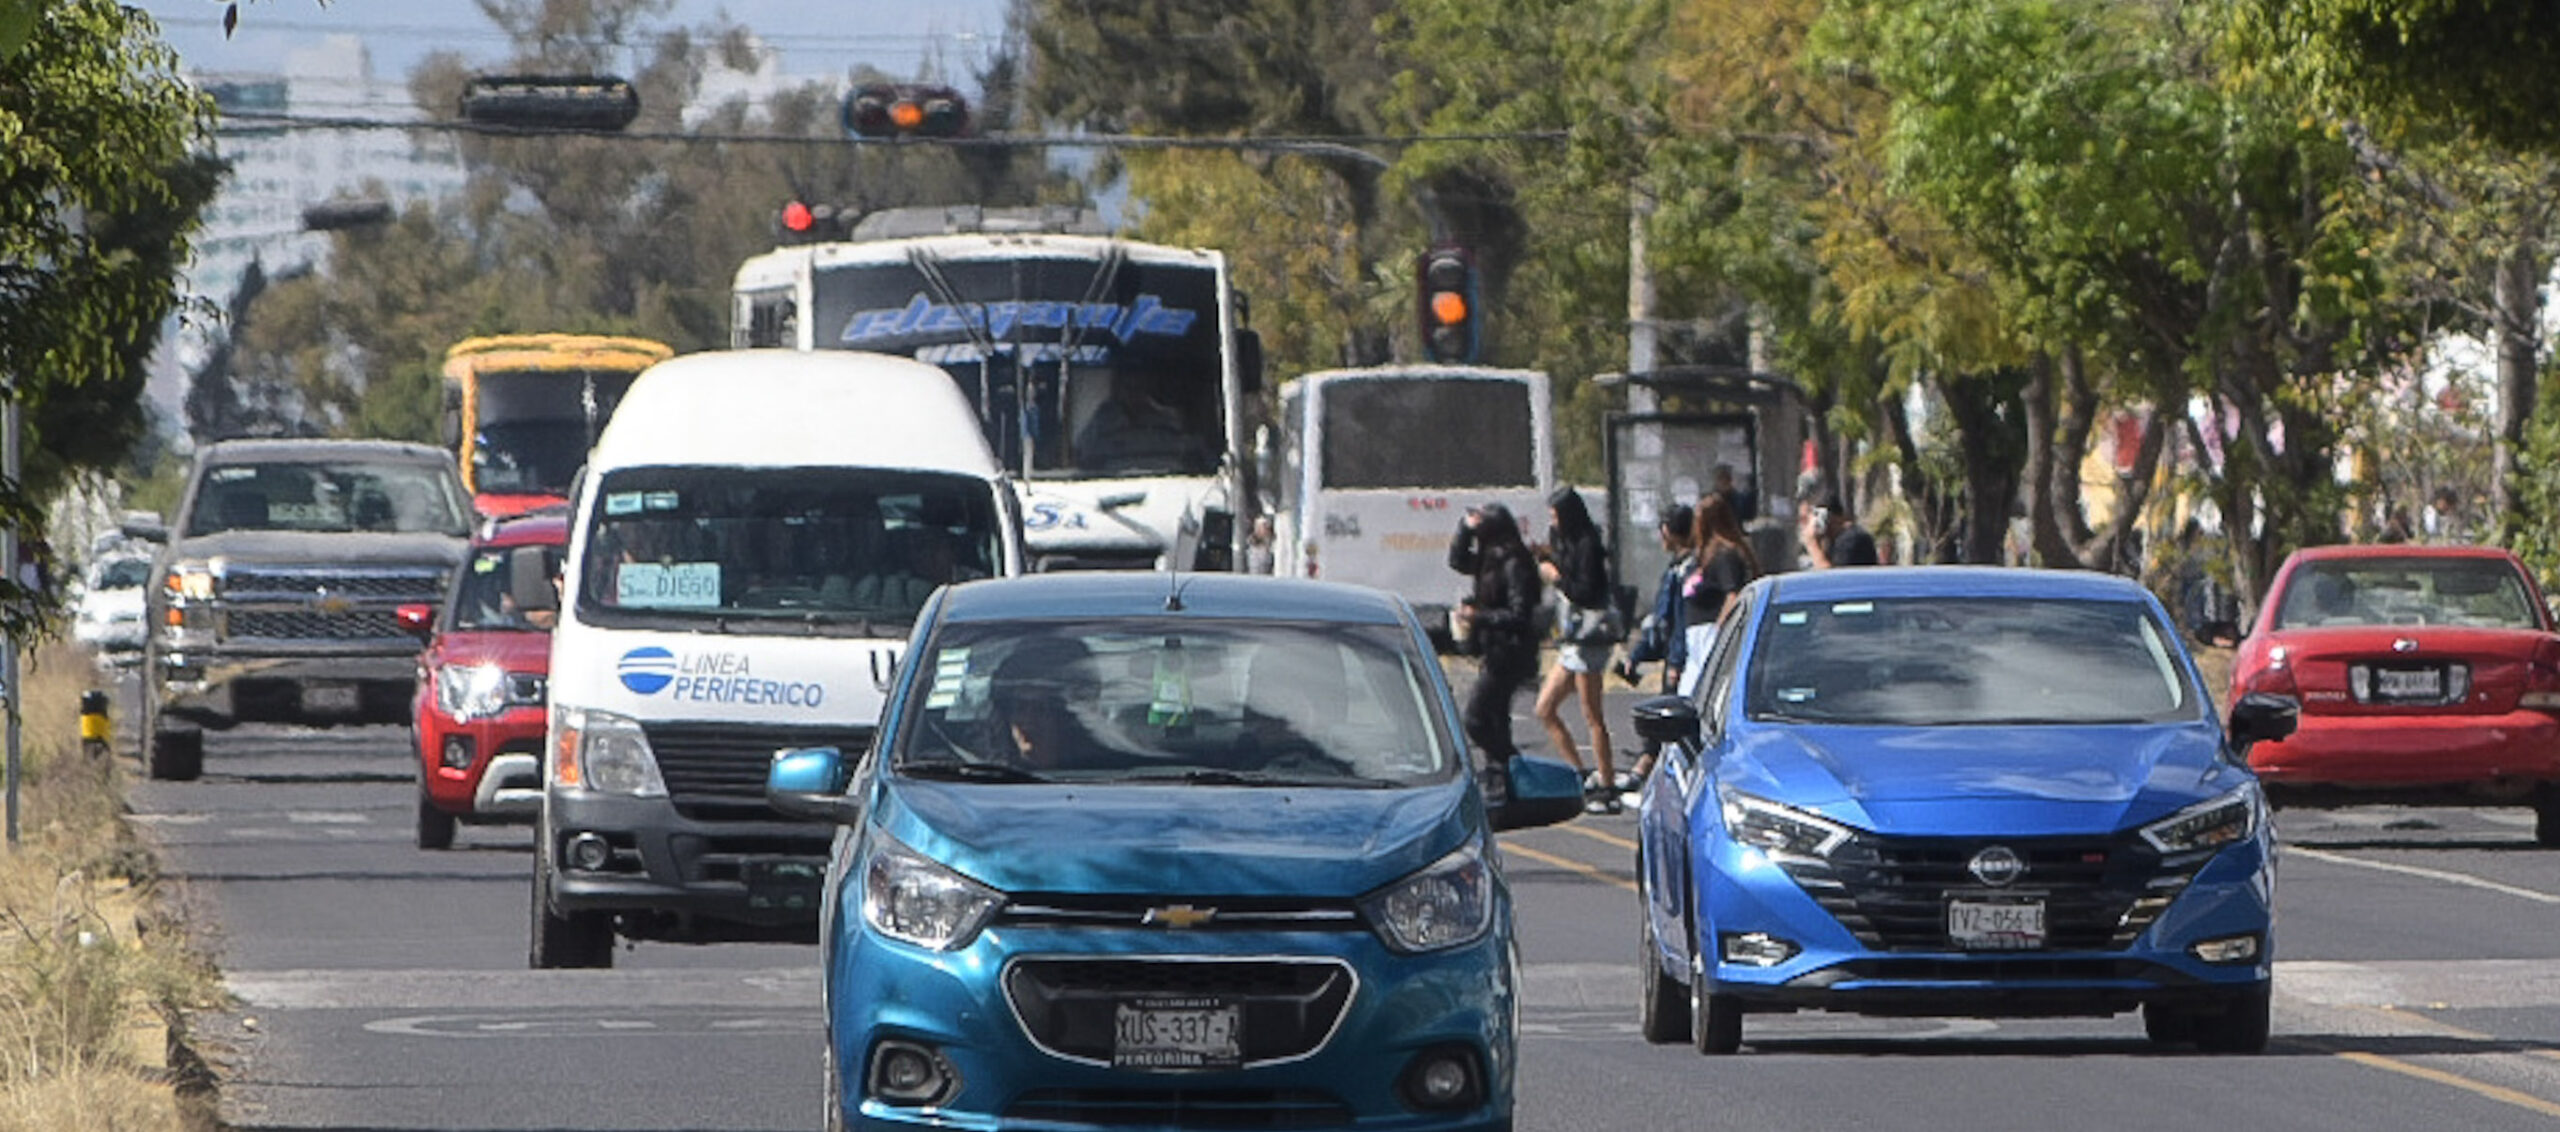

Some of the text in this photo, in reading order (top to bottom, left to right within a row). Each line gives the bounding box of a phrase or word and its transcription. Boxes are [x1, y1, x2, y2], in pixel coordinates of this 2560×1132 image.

[680, 653, 750, 676] LINEA
[673, 676, 824, 708] PERIFERICO
[1115, 1011, 1241, 1046] XUS-337-A
